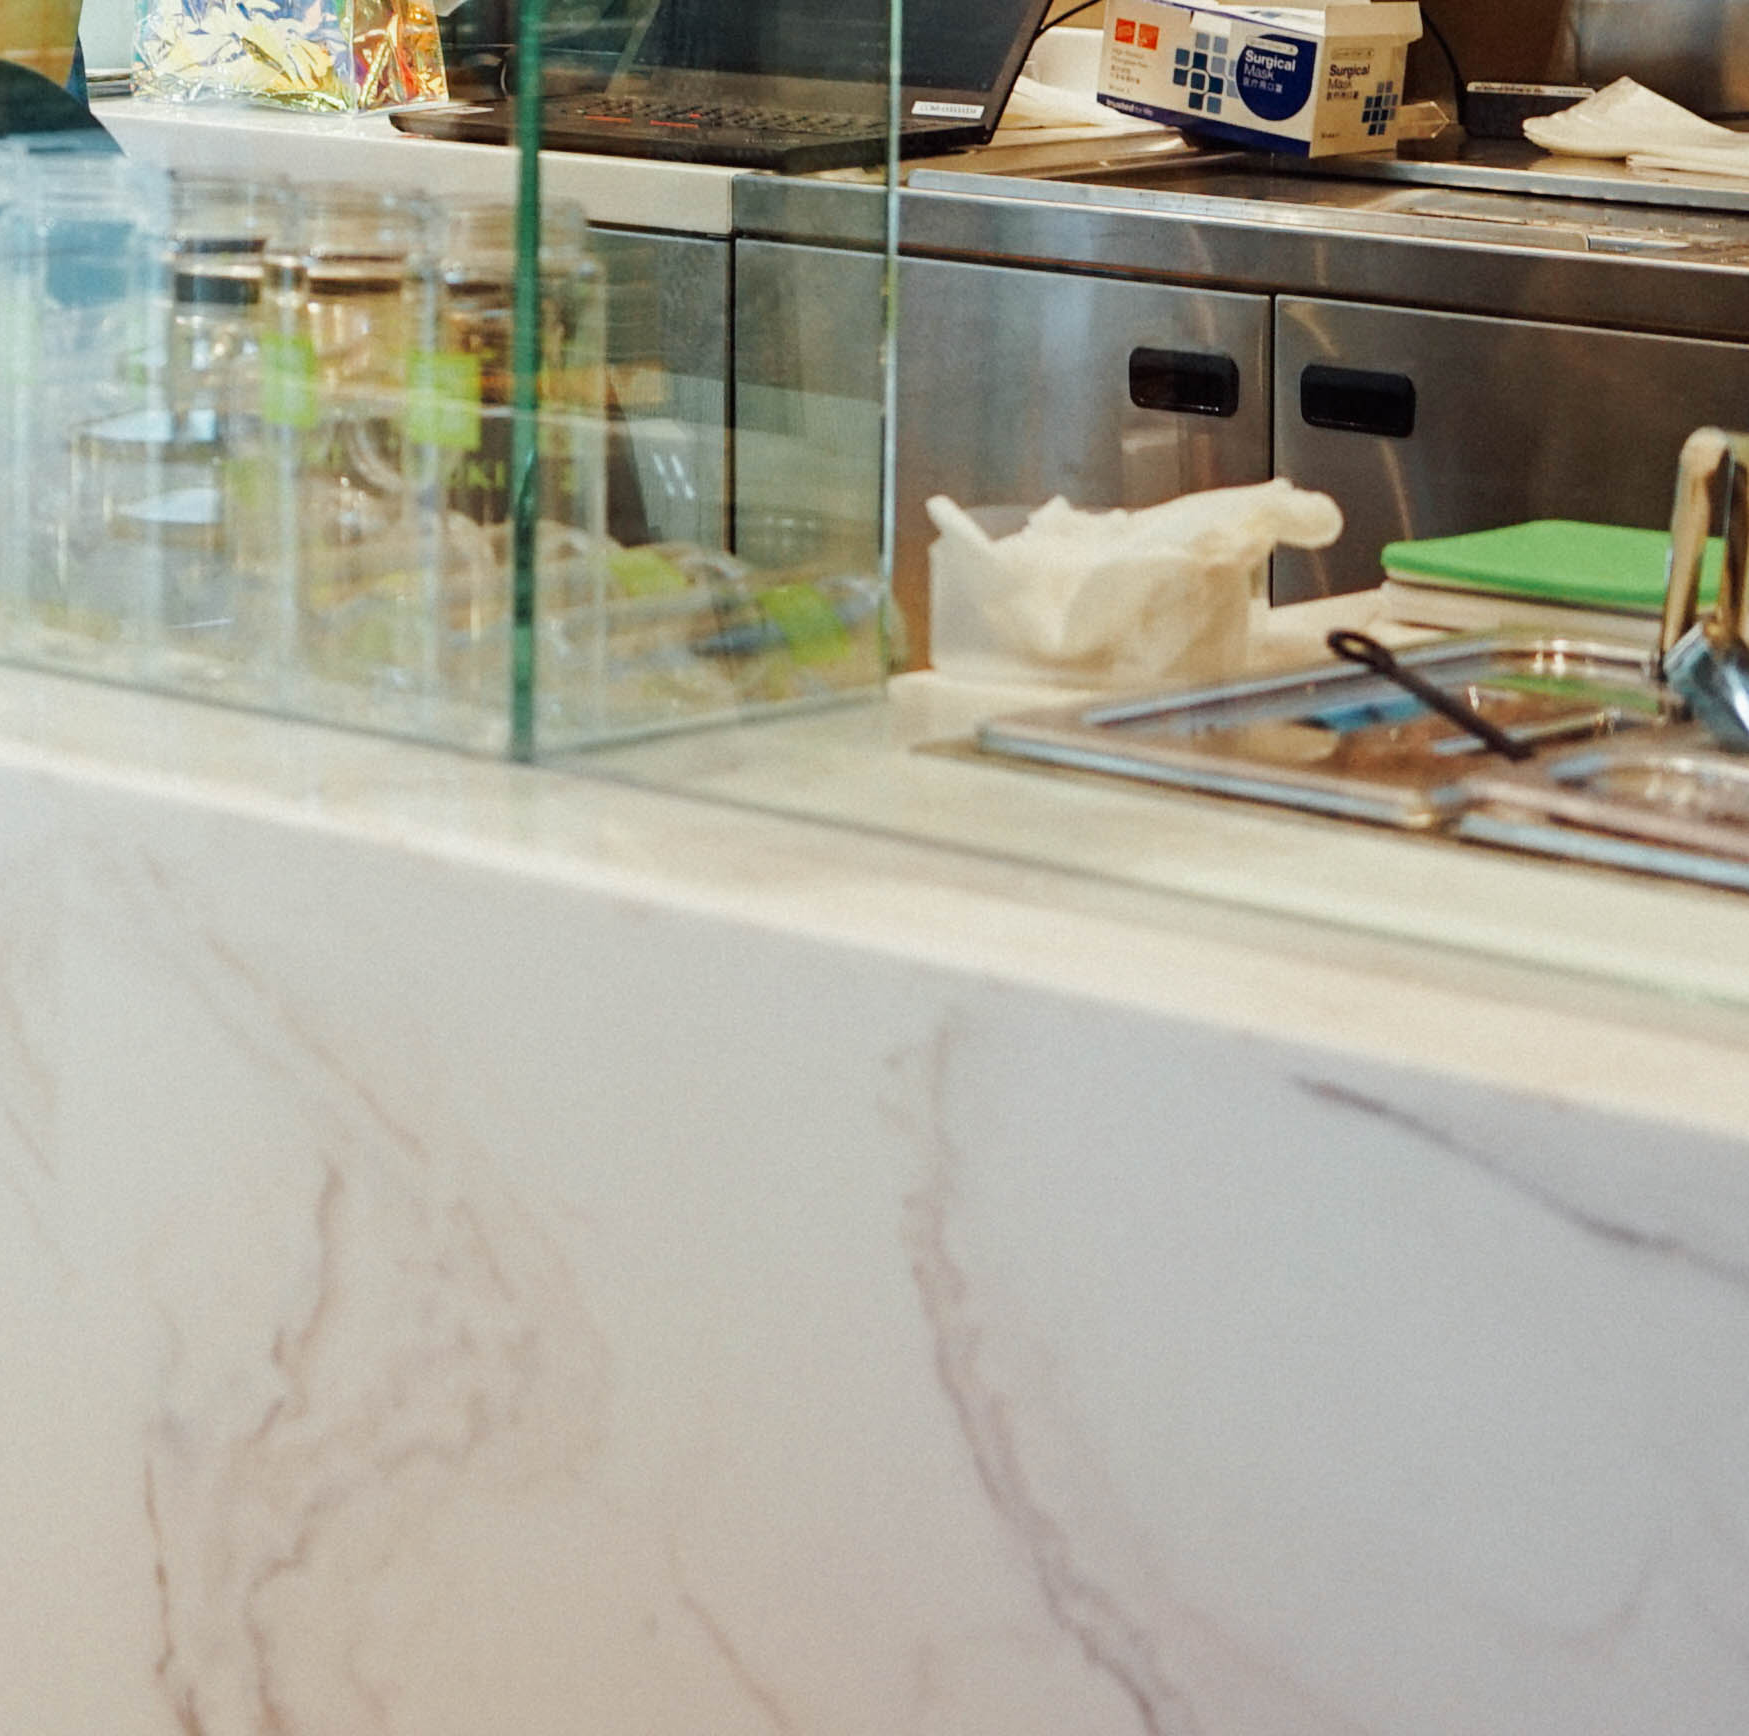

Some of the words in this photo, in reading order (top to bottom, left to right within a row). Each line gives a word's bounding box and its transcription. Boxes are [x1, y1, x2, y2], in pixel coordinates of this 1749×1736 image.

[1245, 49, 1296, 72] Surgical
[1243, 63, 1274, 80] Mask
[1329, 63, 1371, 79] Surgical
